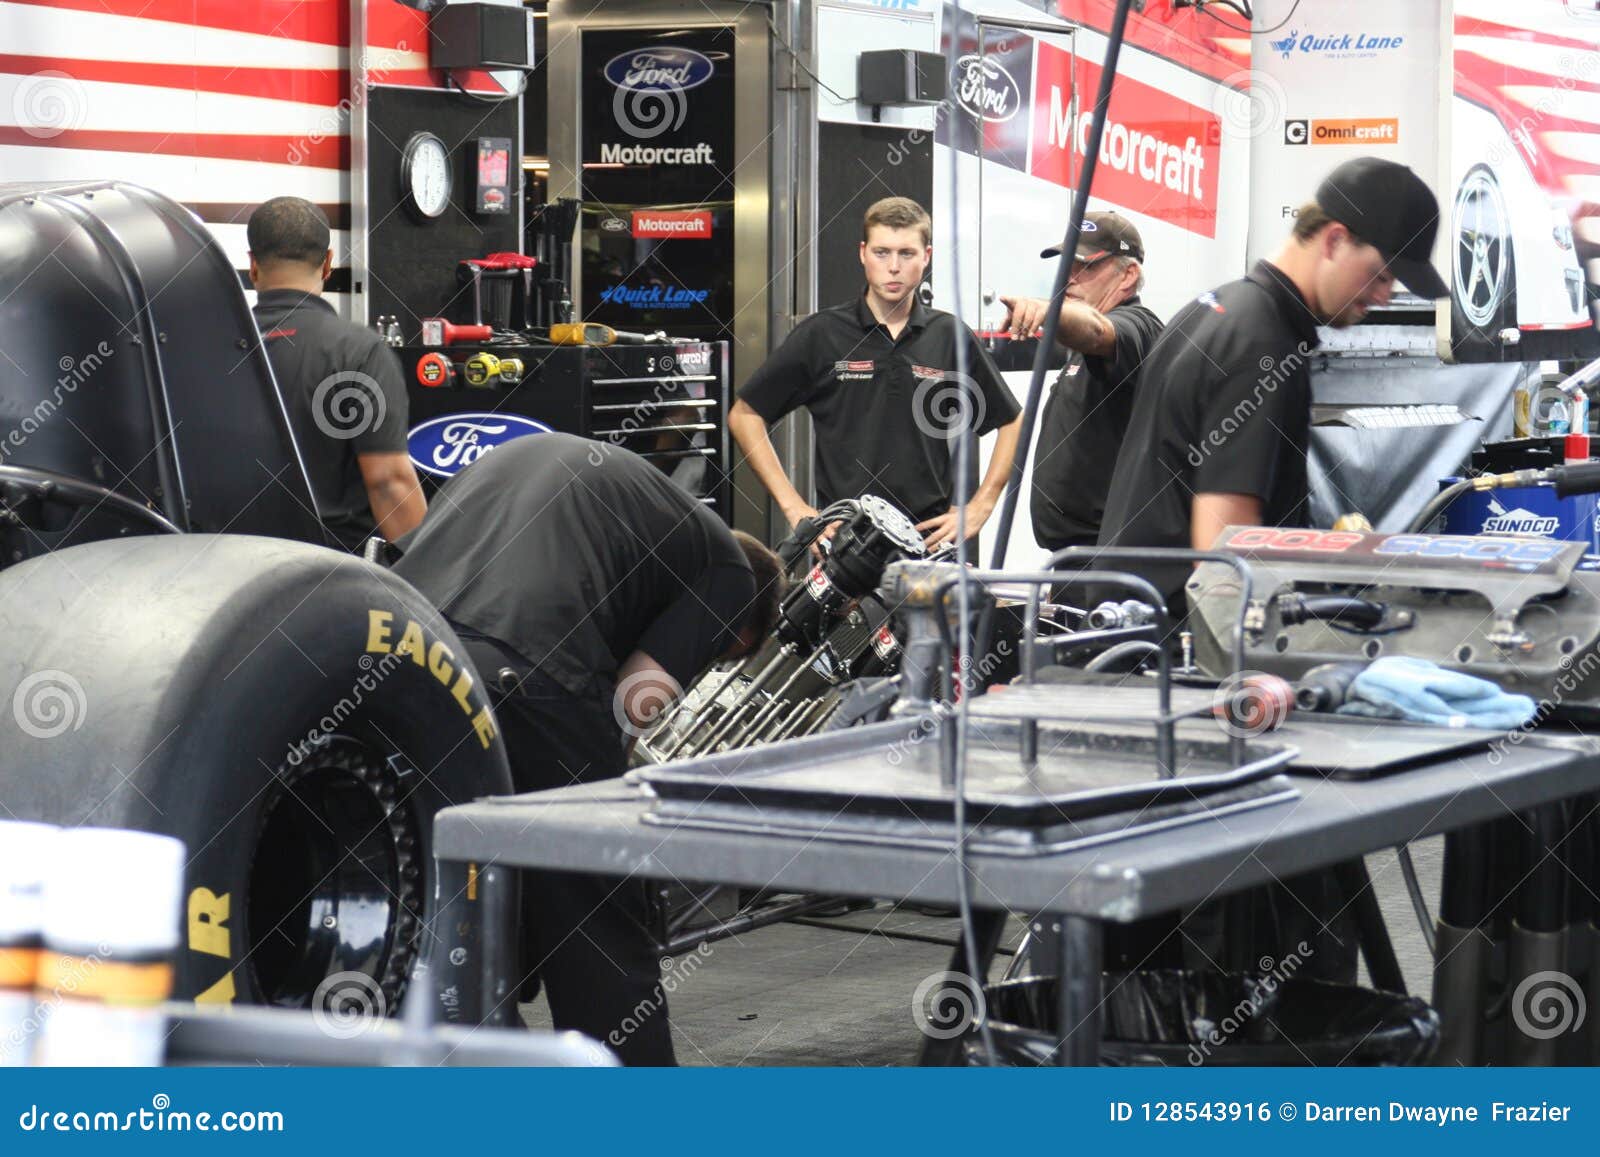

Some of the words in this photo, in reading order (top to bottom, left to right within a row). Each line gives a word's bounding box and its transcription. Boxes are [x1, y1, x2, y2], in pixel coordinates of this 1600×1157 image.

[1299, 34, 1353, 52] Quick
[1355, 33, 1403, 49] Lane
[625, 53, 693, 86] Ford
[1315, 124, 1393, 138] Omnicraft
[1049, 85, 1204, 201] Motorcraft
[600, 143, 714, 164] Motorcraft
[637, 218, 705, 231] Motorcraft
[613, 286, 662, 304] Quick
[664, 286, 709, 302] Lane
[432, 422, 507, 467] Fo
[1485, 519, 1557, 532] SUNOCO
[366, 609, 498, 749] EAGLE
